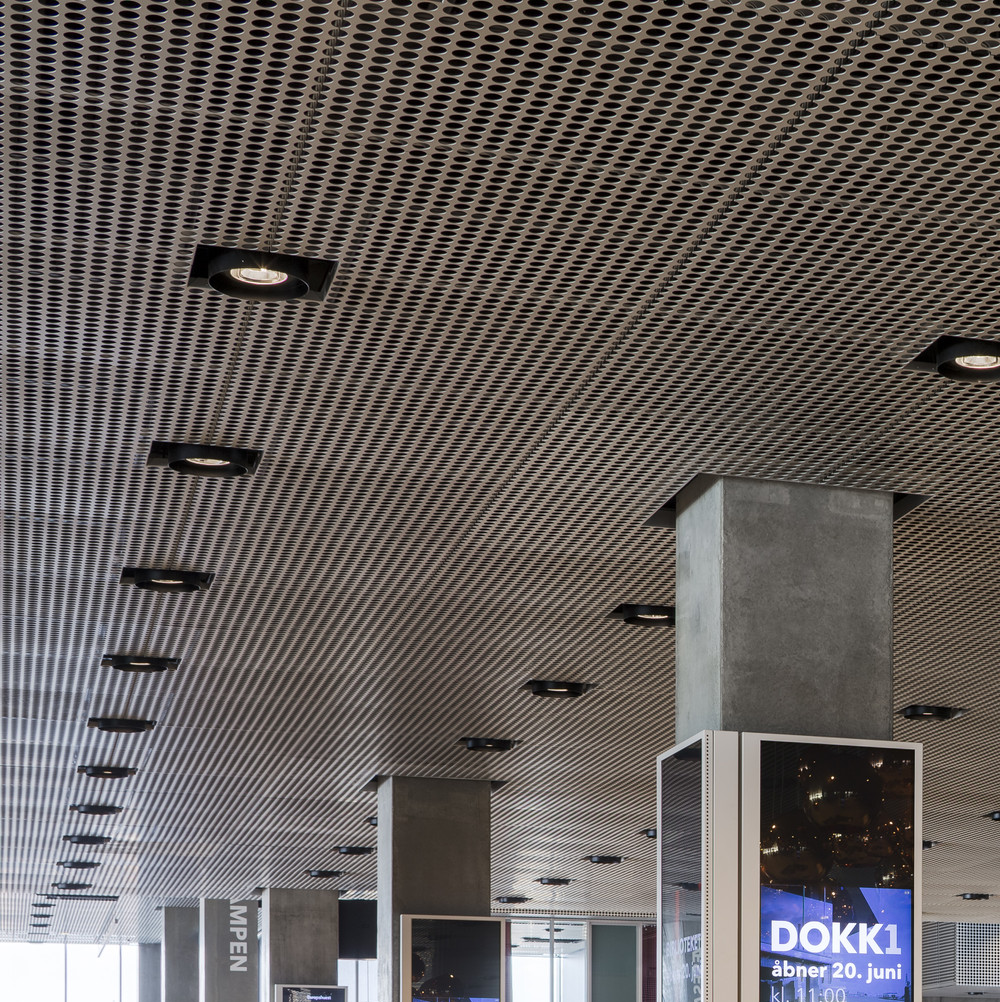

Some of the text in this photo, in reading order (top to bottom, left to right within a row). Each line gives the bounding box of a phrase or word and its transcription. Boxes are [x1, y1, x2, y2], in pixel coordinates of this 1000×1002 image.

[771, 920, 901, 955] DOKK1
[771, 960, 902, 983] åbner 20. juni
[771, 986, 789, 1002] kl.
